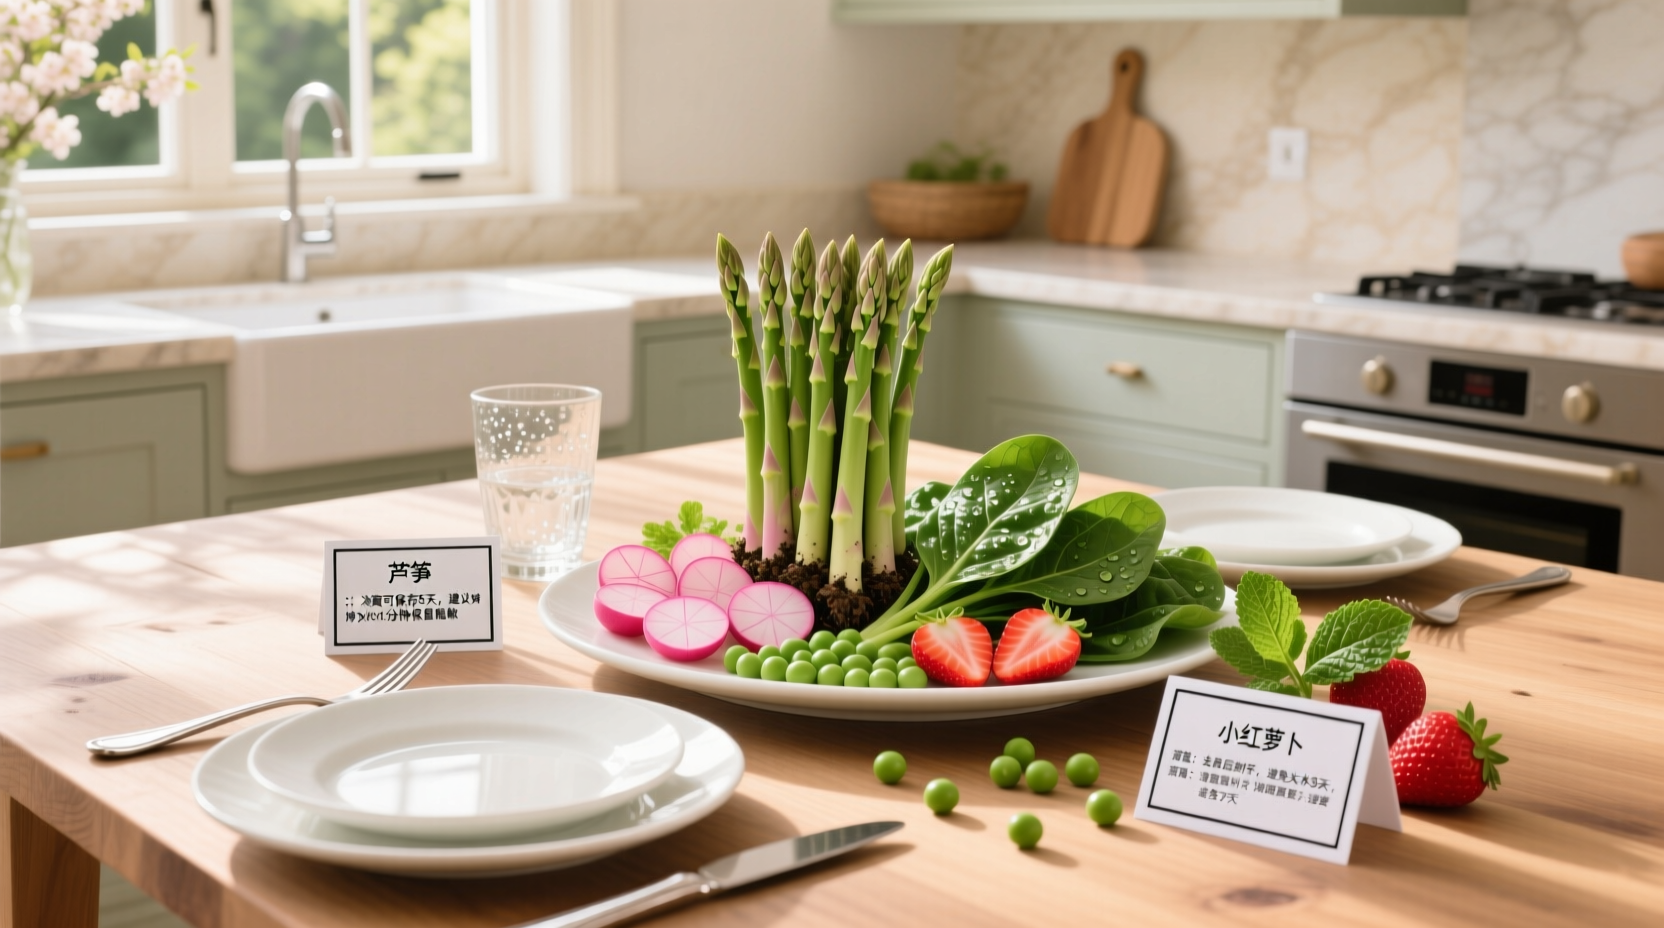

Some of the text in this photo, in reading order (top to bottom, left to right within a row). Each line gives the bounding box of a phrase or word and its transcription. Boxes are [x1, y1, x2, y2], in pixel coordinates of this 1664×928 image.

[388, 561, 432, 584] 芦笋
[1218, 720, 1303, 756] 小红萝卜
